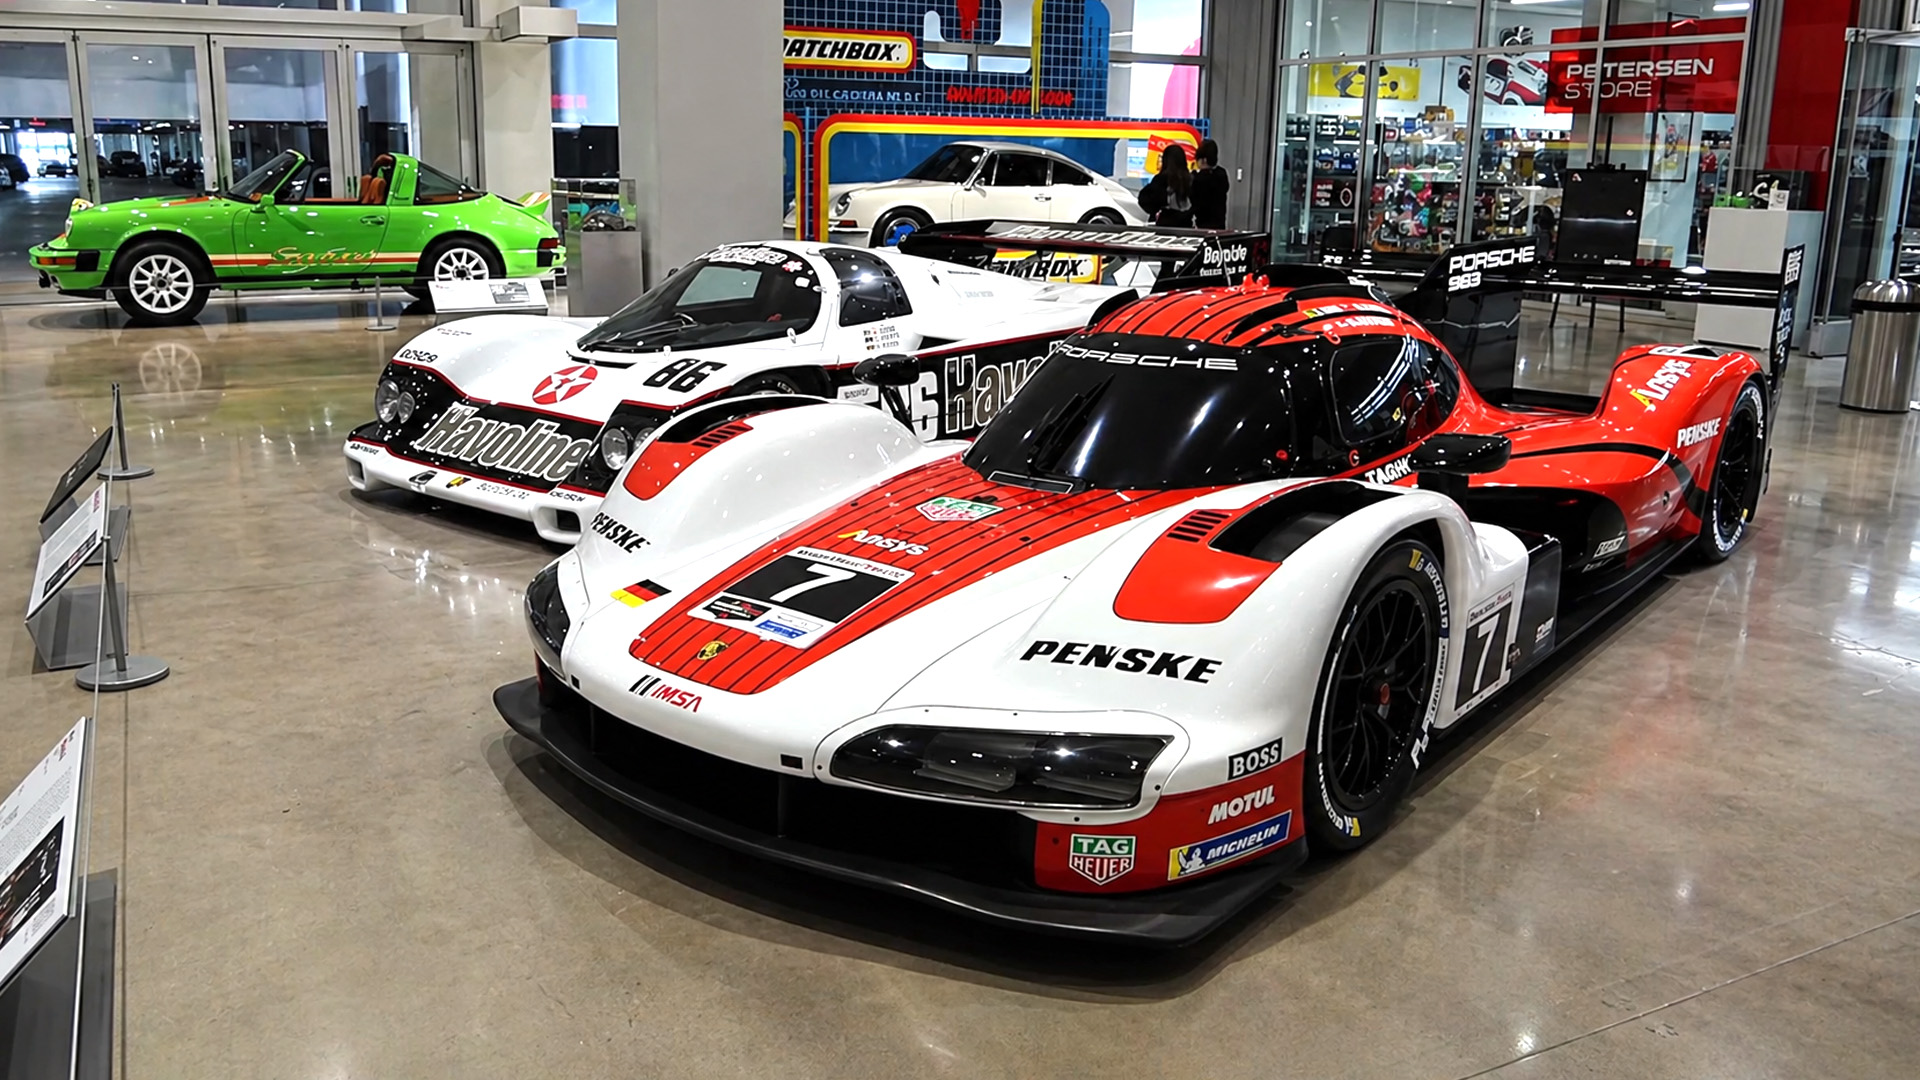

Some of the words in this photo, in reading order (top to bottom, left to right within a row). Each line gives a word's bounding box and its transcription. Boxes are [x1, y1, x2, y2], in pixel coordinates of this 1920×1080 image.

[1566, 58, 1714, 79] PETERSEN
[1564, 81, 1652, 99] STORE
[1449, 246, 1536, 275] PORSCHE
[1056, 344, 1238, 371] PORSCHE
[642, 358, 727, 393] 86
[412, 401, 596, 482] Havoline
[1676, 417, 1721, 449] PENSKE
[837, 529, 929, 555] Ansys
[769, 562, 857, 603] 7
[1020, 640, 1222, 684] PENSKE
[1472, 612, 1500, 694] 7
[650, 684, 702, 713] IMSA
[1232, 743, 1280, 777] BOSS
[1208, 785, 1275, 824] MOTUL
[1077, 837, 1130, 854] TAG
[1207, 823, 1280, 860] MICHELIN
[1072, 856, 1132, 881] HEUER
